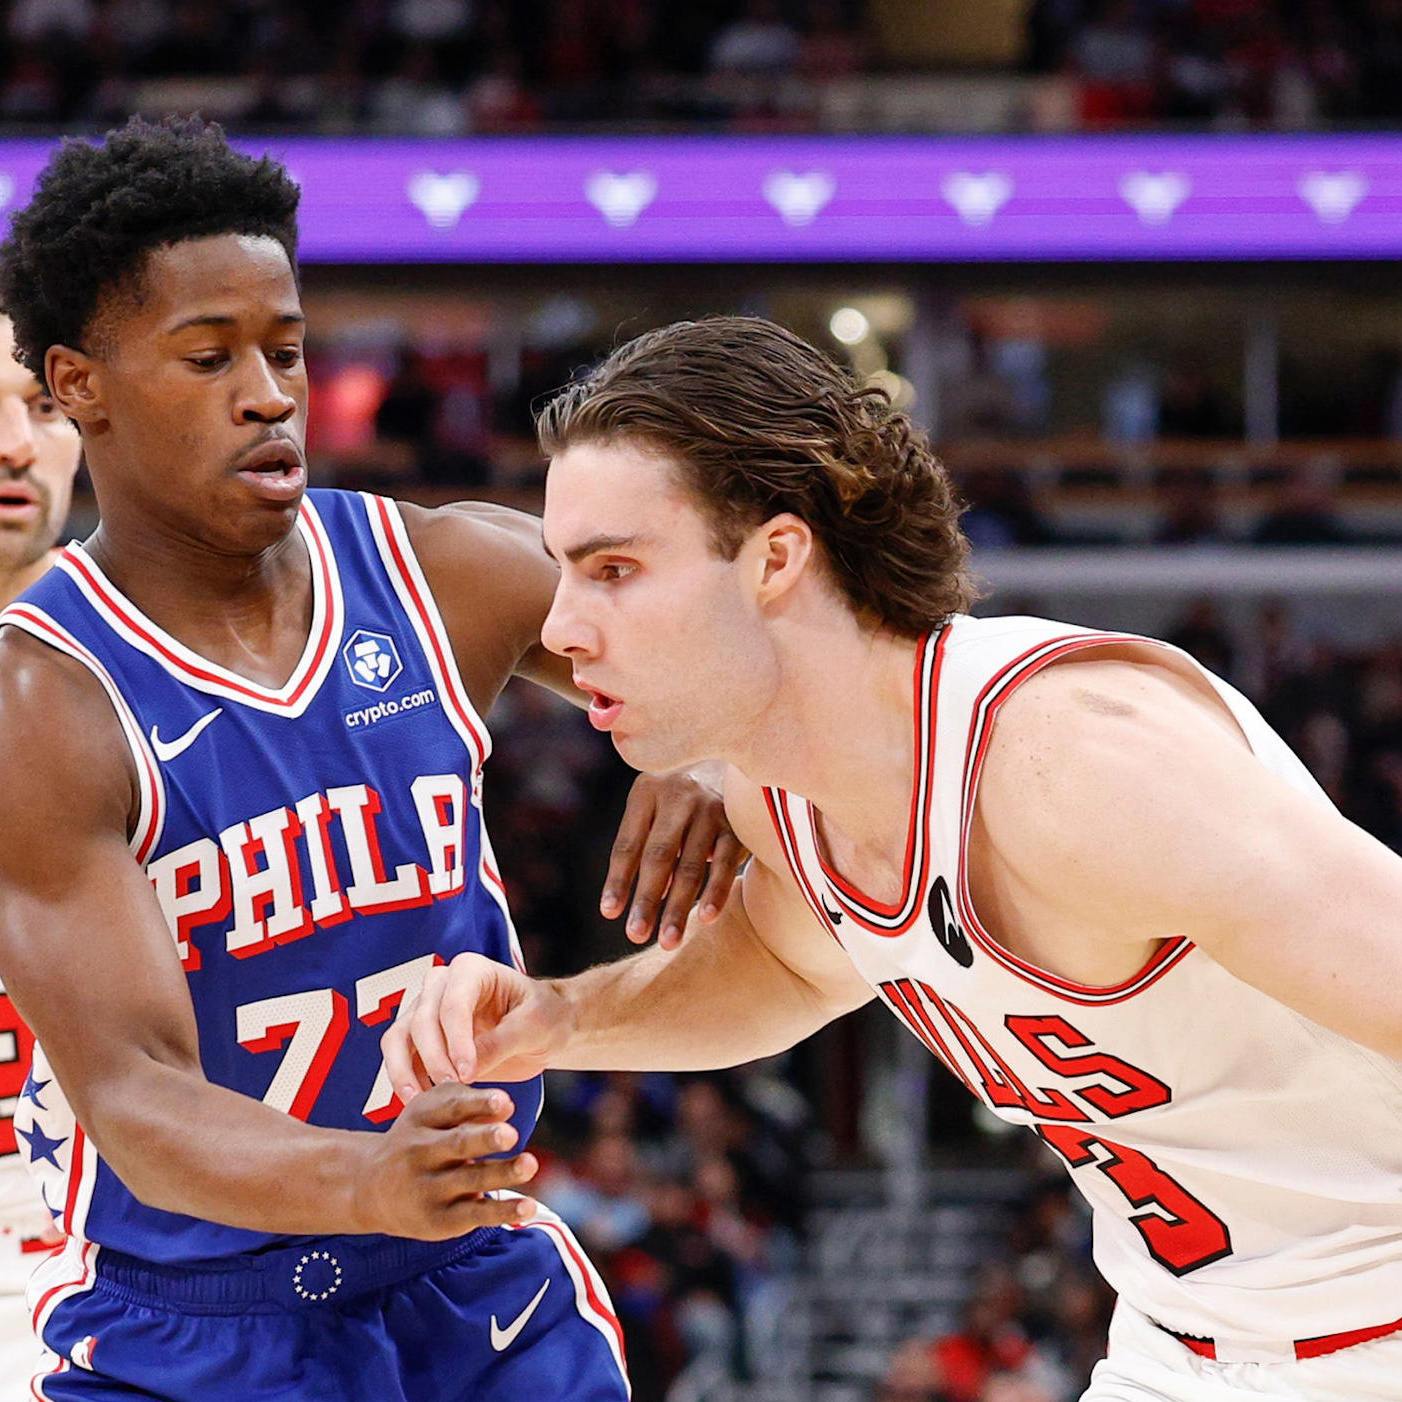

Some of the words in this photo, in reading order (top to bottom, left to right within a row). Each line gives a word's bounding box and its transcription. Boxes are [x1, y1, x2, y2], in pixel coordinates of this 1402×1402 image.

[345, 689, 435, 727] crypto.com
[147, 772, 466, 973] PHILA
[1035, 1124, 1234, 1277] 3
